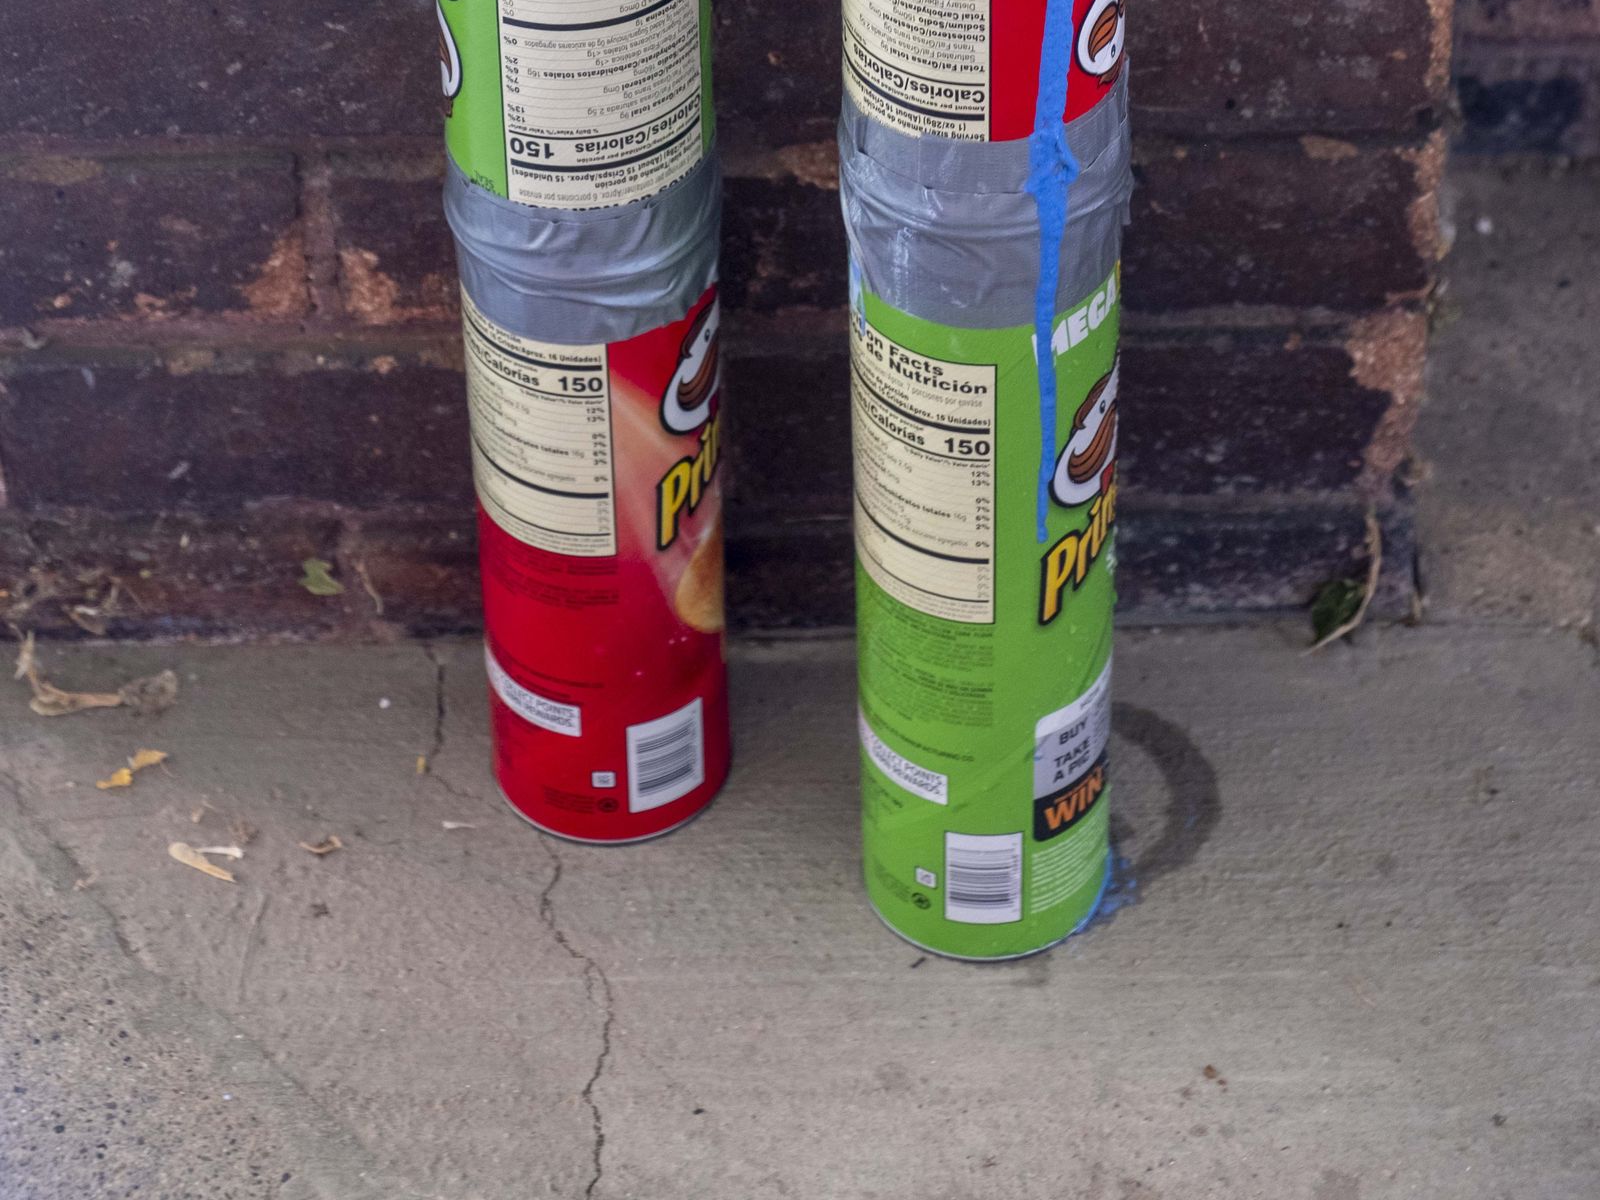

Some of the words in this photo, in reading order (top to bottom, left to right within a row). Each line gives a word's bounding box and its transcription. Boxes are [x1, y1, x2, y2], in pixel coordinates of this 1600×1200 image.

[502, 7, 515, 17] 0%
[619, 3, 640, 13] 0mcg
[882, 12, 985, 41] Cholesterol/Colesterol
[918, 17, 985, 31] Sodium/Sodio
[503, 35, 518, 45] 0%
[524, 40, 557, 49] agregados
[597, 38, 605, 46] 0g
[912, 34, 949, 50] Fat/Grasa
[603, 45, 628, 55] totales
[951, 43, 975, 52] Trans
[577, 35, 686, 78] Carbohydrate/Carbohidratos
[611, 50, 642, 62] dietética
[889, 47, 909, 61] total
[936, 51, 976, 62] Saturated
[505, 55, 518, 65] 2%
[595, 58, 609, 67] <1g
[911, 56, 957, 72] Fat/Grasa
[505, 65, 519, 74] 6%
[527, 68, 540, 78] 16g
[506, 75, 519, 83] 7%
[543, 71, 575, 79] totales
[506, 85, 520, 93] 0%
[603, 85, 620, 94] 0mg
[634, 85, 651, 95] trans
[623, 91, 633, 99] 0g
[652, 84, 686, 107] Fat/Grasa
[507, 104, 525, 113] 13%
[606, 101, 638, 111] saturada
[631, 104, 650, 117] total
[507, 113, 525, 123] 12%
[895, 107, 921, 123] (About
[575, 94, 700, 154] Calories/Calorías
[510, 137, 554, 159] 150
[638, 153, 662, 169] (About
[512, 167, 553, 181] Unidades)
[567, 169, 625, 181] Crisps/Aprox.
[627, 166, 635, 174] 15
[595, 177, 626, 189] porción
[629, 174, 638, 182] de
[592, 193, 597, 201] 6
[559, 354, 601, 363] Unidades)
[889, 345, 944, 376] Facts
[866, 342, 883, 361] de
[889, 360, 988, 394] Nutrición
[558, 376, 603, 392] 150
[947, 413, 991, 426] Unidades)
[944, 437, 990, 456] 150
[971, 470, 990, 478] 12%
[971, 479, 990, 487] 13%
[1060, 720, 1088, 746] BUY
[1053, 735, 1090, 768] TAKE
[1052, 770, 1064, 783] A
[1068, 750, 1090, 774] PIC
[1044, 765, 1102, 830] WIN
